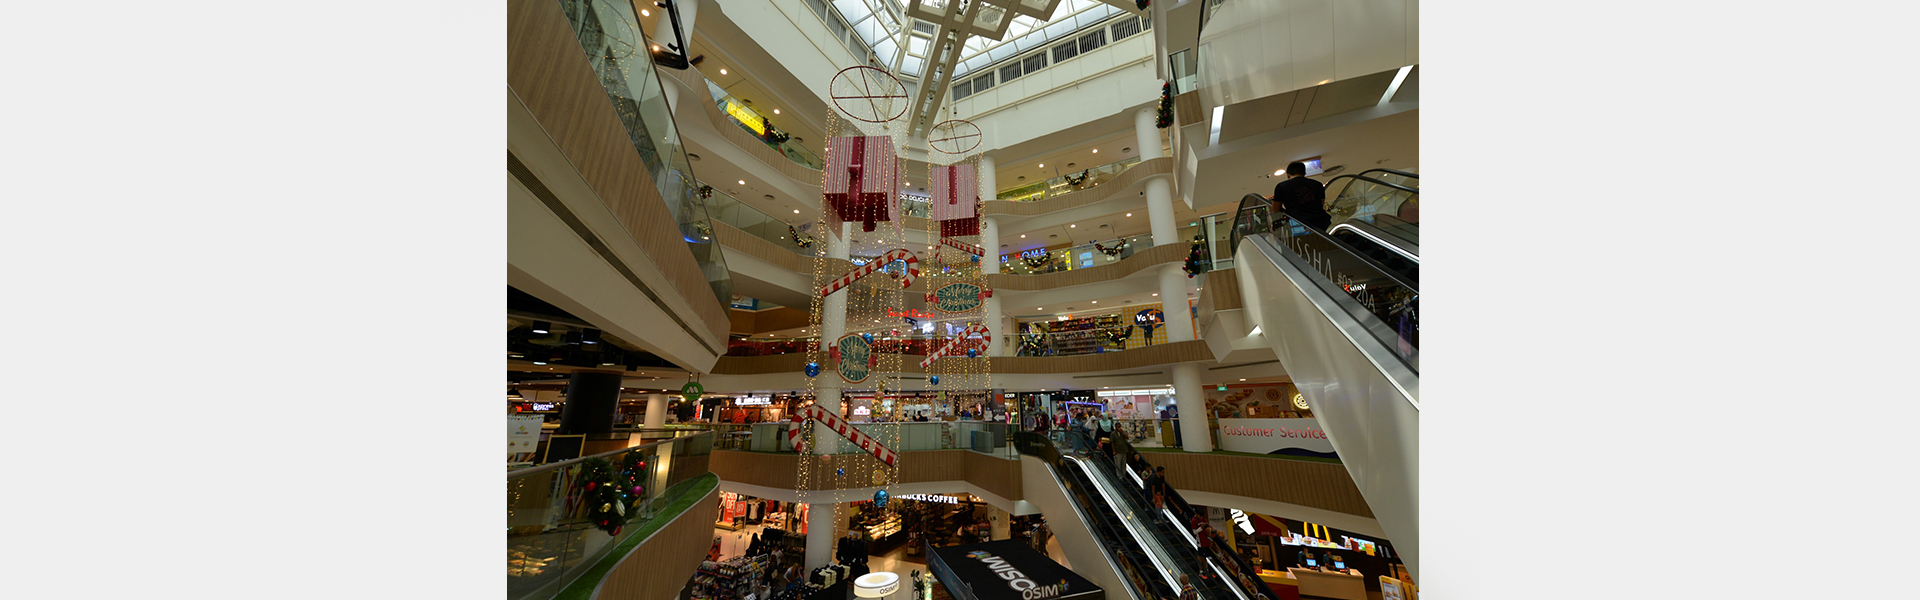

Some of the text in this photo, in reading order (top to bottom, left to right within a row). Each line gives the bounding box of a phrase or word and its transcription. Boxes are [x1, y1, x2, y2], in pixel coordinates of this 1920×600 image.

[1015, 248, 1046, 260] HOME
[887, 307, 935, 320] Secret Recipe
[1223, 425, 1328, 440] Customer Service
[891, 493, 958, 505] BUCKS COFFEE
[1022, 584, 1059, 600] OSIM
